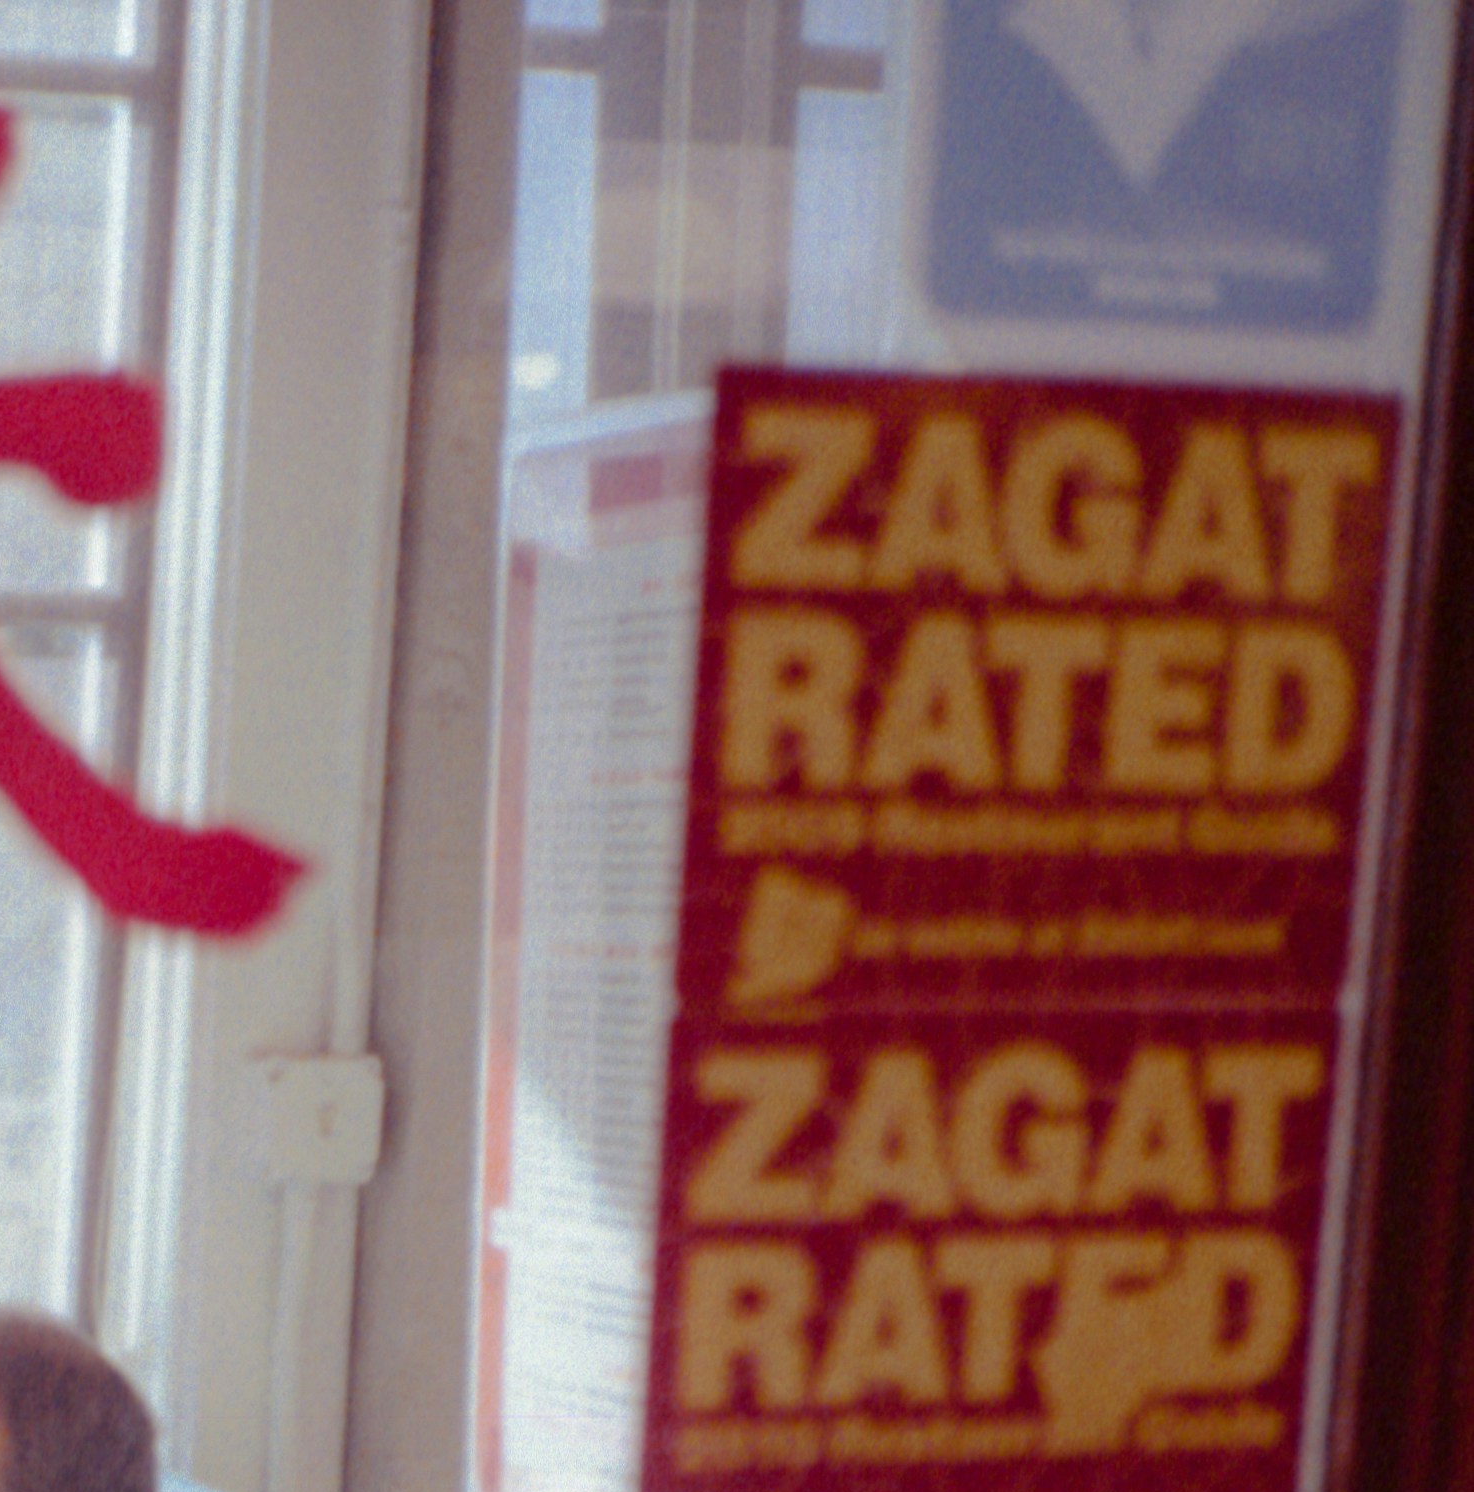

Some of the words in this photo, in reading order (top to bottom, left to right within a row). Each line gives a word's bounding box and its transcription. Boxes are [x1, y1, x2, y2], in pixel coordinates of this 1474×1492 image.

[727, 404, 1381, 600] ZAGAT
[718, 606, 1357, 794] RATED
[685, 1040, 1323, 1220] ZAGAT
